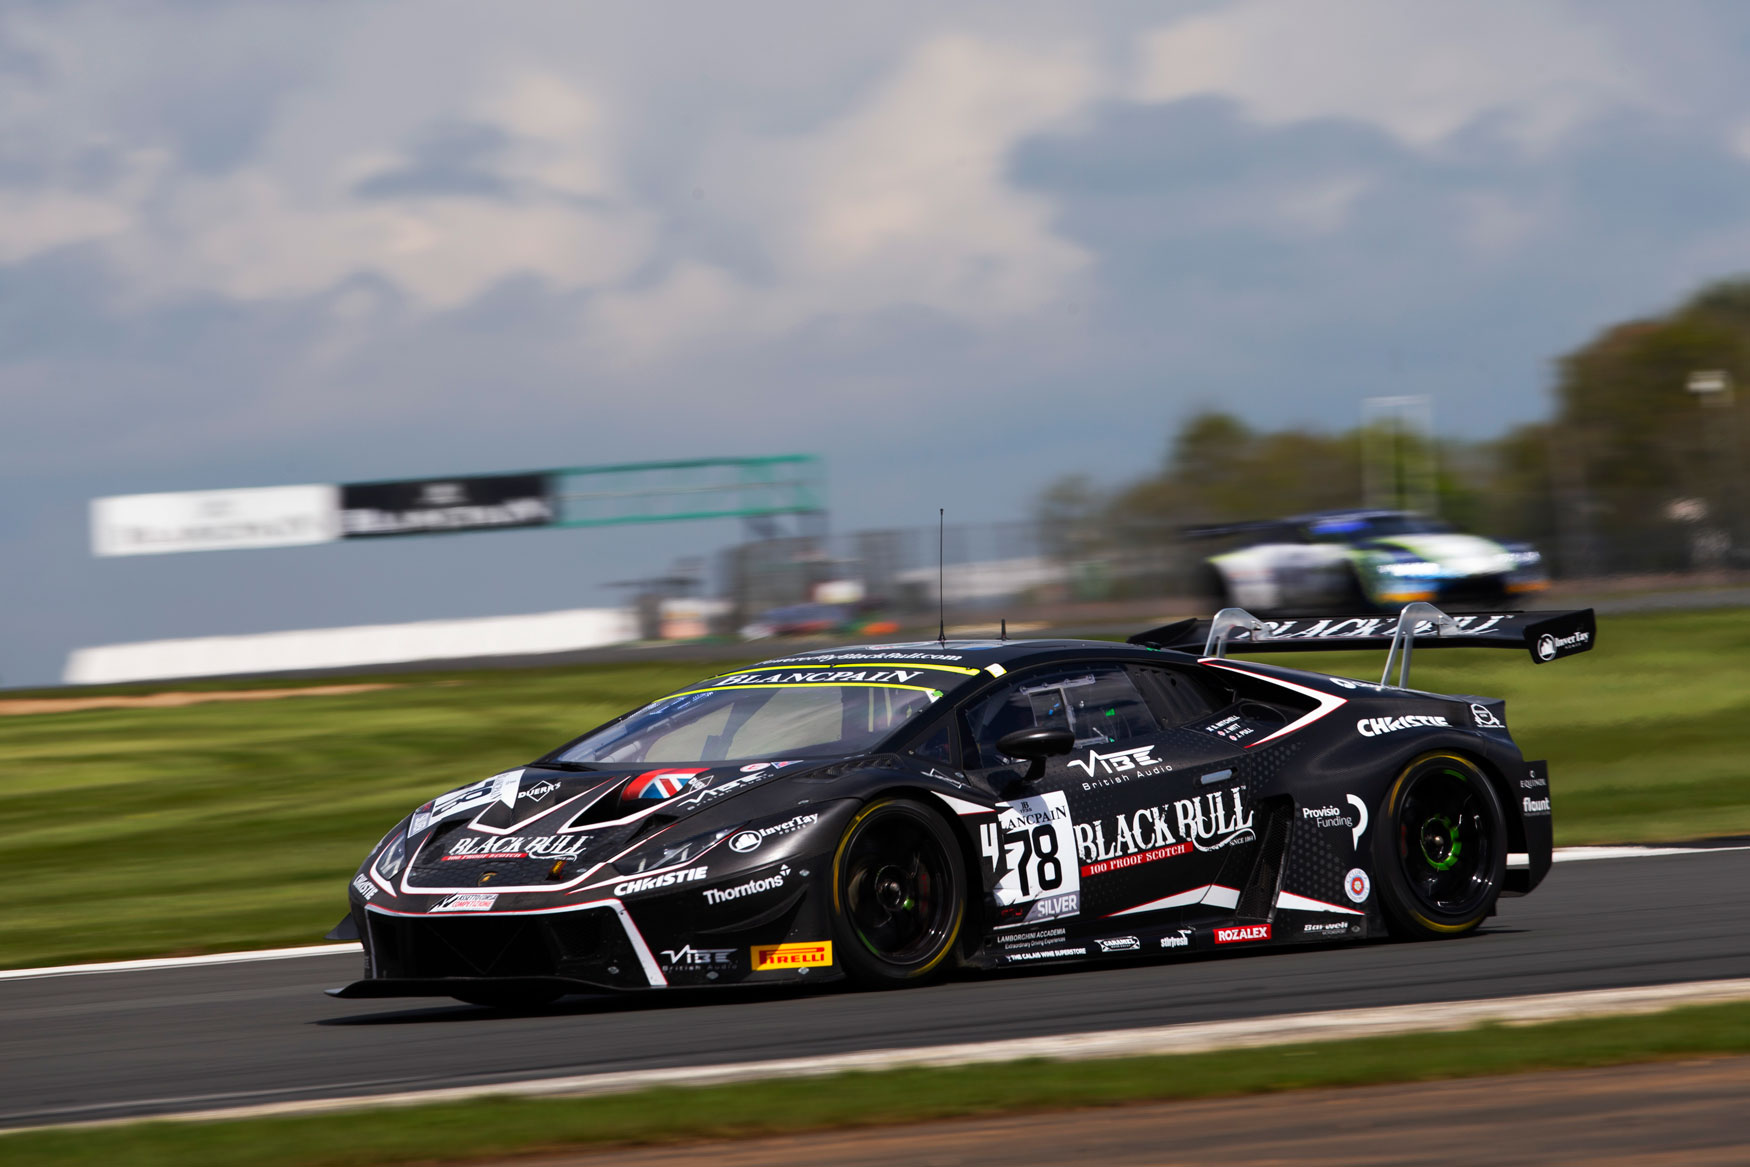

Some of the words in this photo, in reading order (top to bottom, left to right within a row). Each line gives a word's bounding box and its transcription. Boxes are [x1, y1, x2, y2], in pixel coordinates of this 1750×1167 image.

[712, 670, 924, 687] BLANCPAIN
[1357, 715, 1452, 737] CHRISTIE
[1066, 744, 1159, 778] VIBE
[1082, 774, 1130, 791] British
[1136, 765, 1173, 779] Audio
[1004, 805, 1067, 830] ANCPAIN
[1302, 805, 1341, 819] Provisio
[1316, 815, 1353, 828] Funding
[761, 813, 818, 837] InverTay
[1073, 804, 1177, 864] BLACK
[1173, 786, 1254, 842] BULL
[449, 836, 531, 856] BLACK
[524, 834, 588, 858] BULL
[1003, 823, 1063, 897] 78
[1090, 862, 1108, 875] 100
[1110, 853, 1144, 870] PROOF
[1146, 844, 1186, 860] SCOTCH
[613, 866, 709, 897] CHRISTIE
[702, 874, 784, 905] Thorntons
[1037, 895, 1078, 917] SILVER
[997, 932, 1036, 943] LAMBORGHINI
[1036, 927, 1067, 938] ACCADEMIA
[1103, 937, 1137, 947] CARAMEL
[1218, 927, 1268, 942] ROZALEX
[660, 944, 739, 964] VIBE
[758, 946, 825, 965] PIRELLI
[1011, 953, 1023, 961] THE
[662, 964, 701, 972] British
